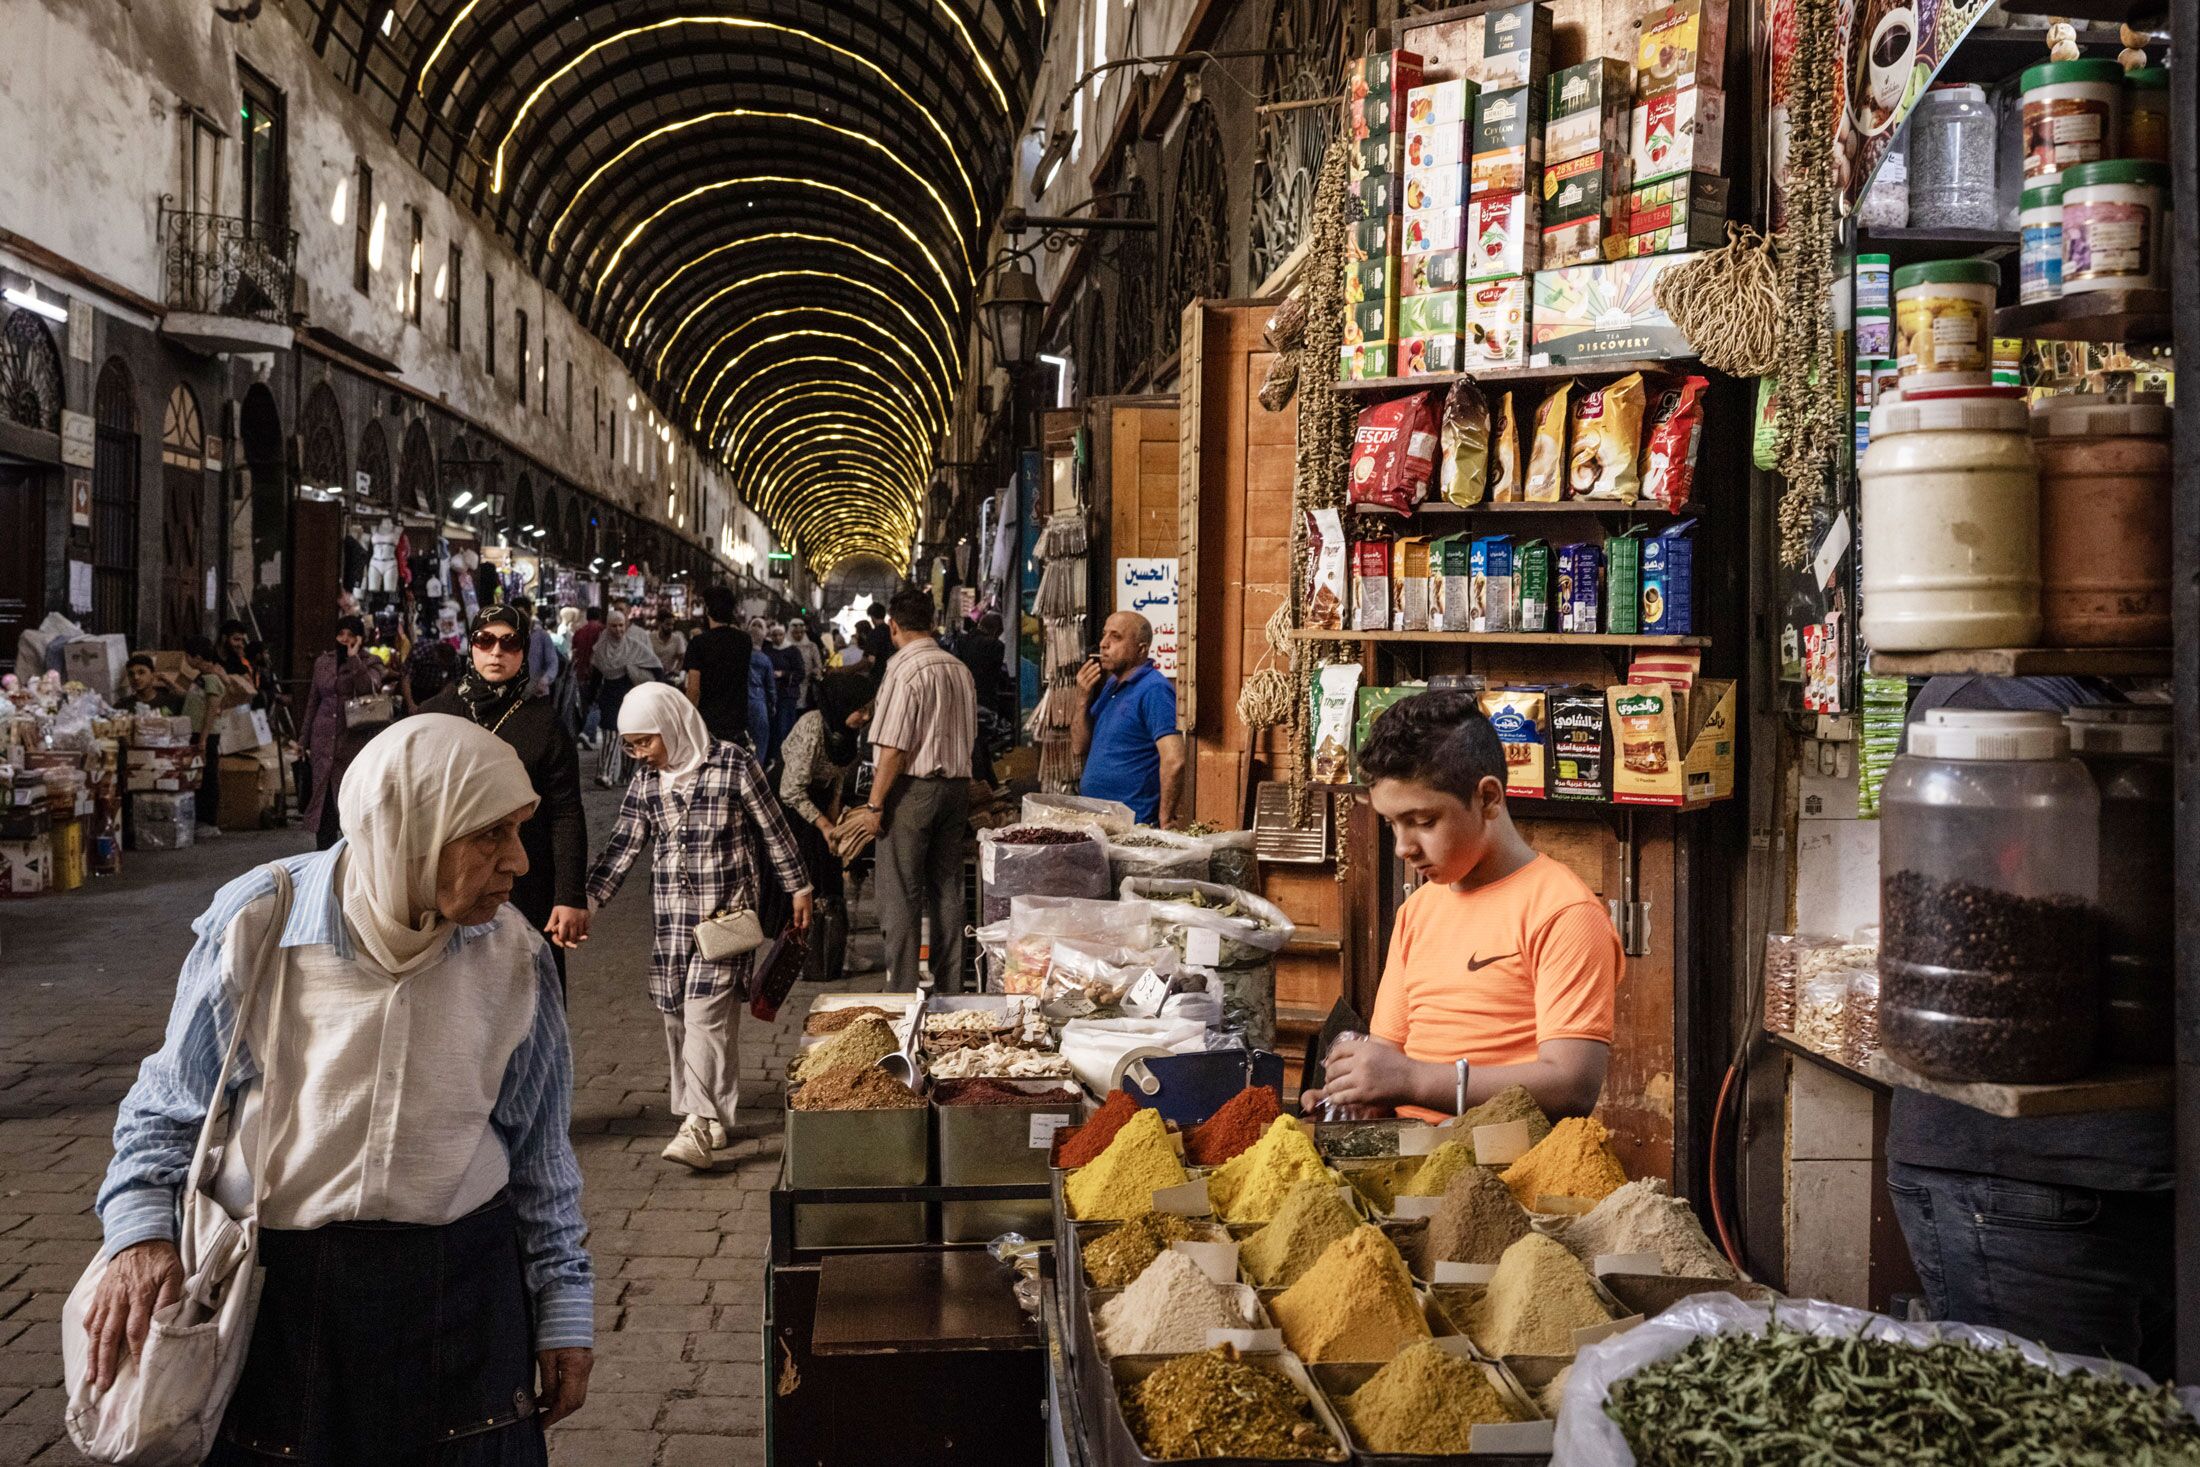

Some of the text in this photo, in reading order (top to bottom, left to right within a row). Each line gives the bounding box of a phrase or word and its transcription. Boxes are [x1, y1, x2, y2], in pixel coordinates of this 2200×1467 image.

[1500, 34, 1513, 42] EARL
[1484, 124, 1514, 136] CEYLON
[1492, 136, 1506, 144] TEA
[1556, 155, 1596, 174] 28% FREE
[1654, 208, 1670, 220] TEAS
[1578, 337, 1650, 352] DISCOVERY
[1125, 563, 1170, 586] الحسين
[1618, 699, 1652, 715] الحموي
[1554, 714, 1602, 731] بن الشامي
[1571, 730, 1588, 742] 100
[1566, 780, 1583, 788] عربية
